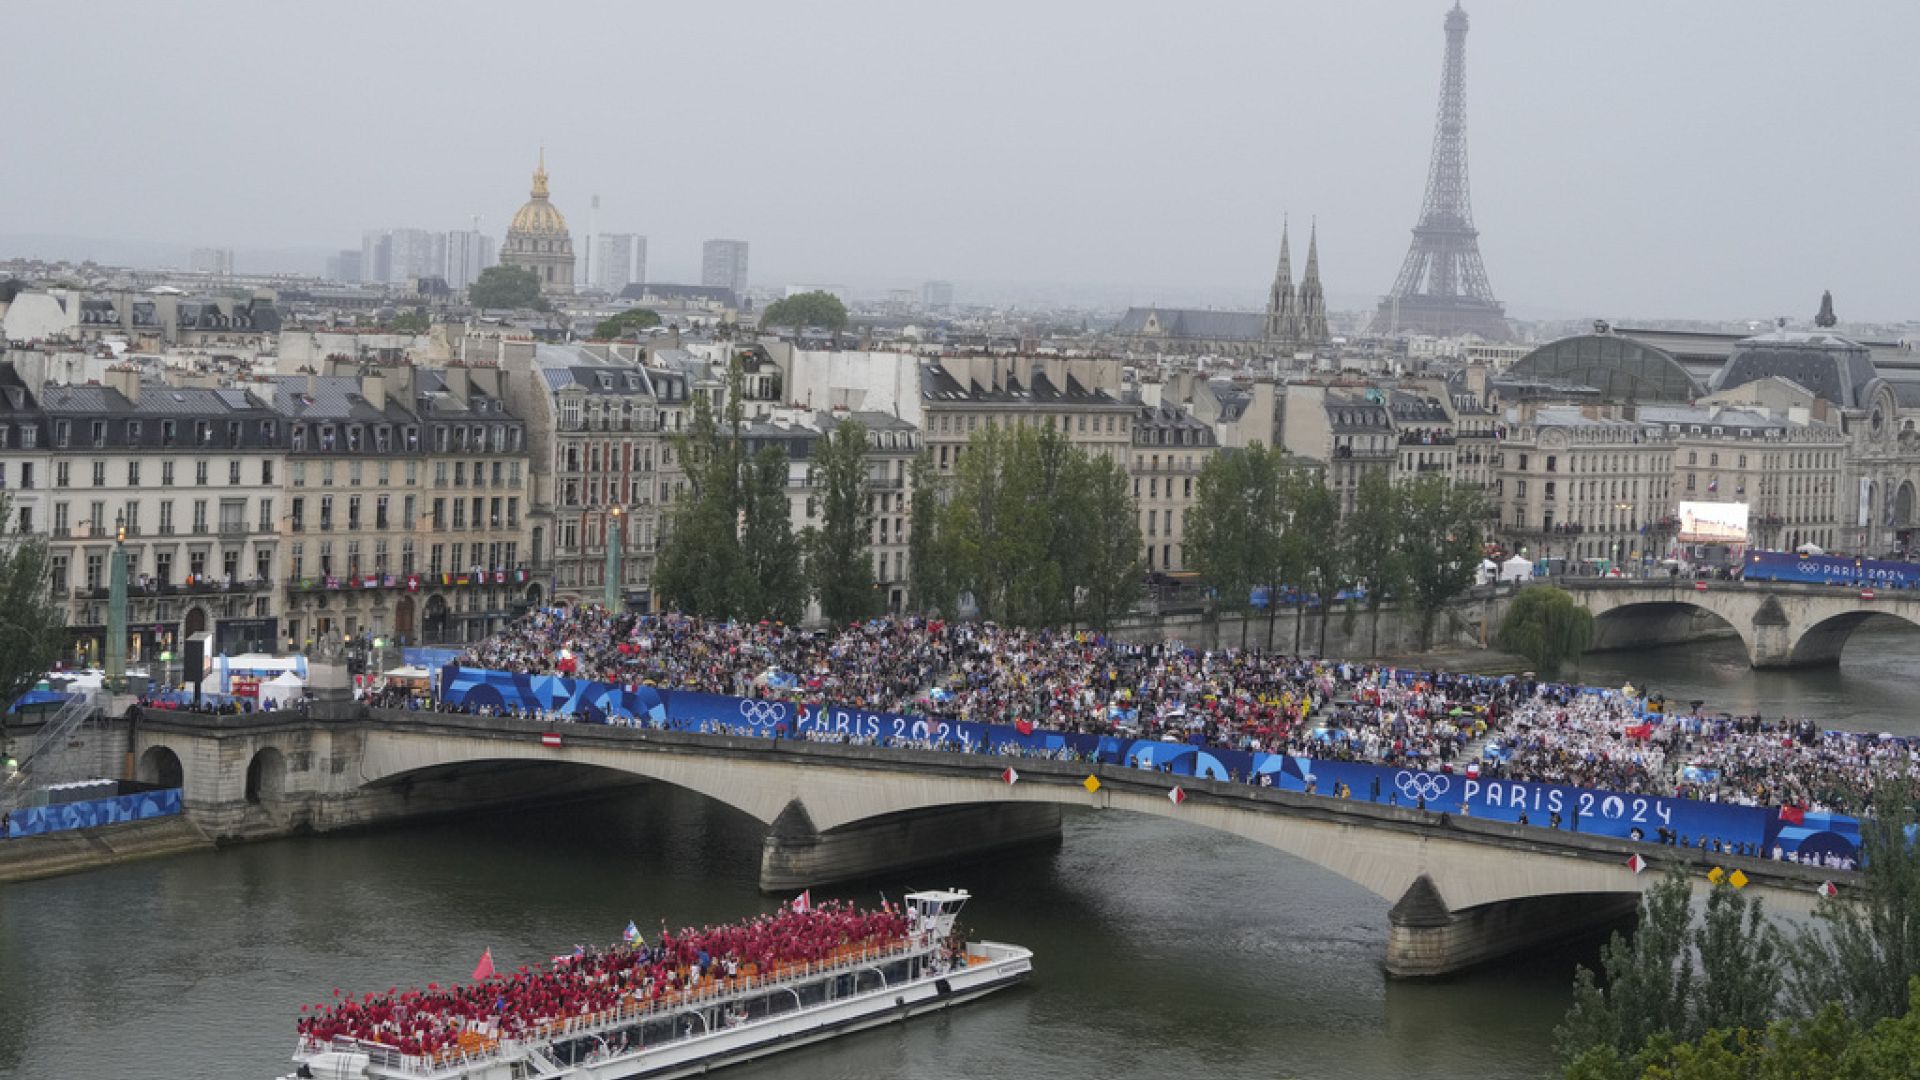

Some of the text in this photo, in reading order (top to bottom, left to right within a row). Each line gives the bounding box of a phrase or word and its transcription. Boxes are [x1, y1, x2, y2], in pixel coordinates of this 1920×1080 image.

[1868, 568, 1904, 580] 2024
[892, 718, 970, 746] 2024
[1579, 793, 1671, 825] 2024
